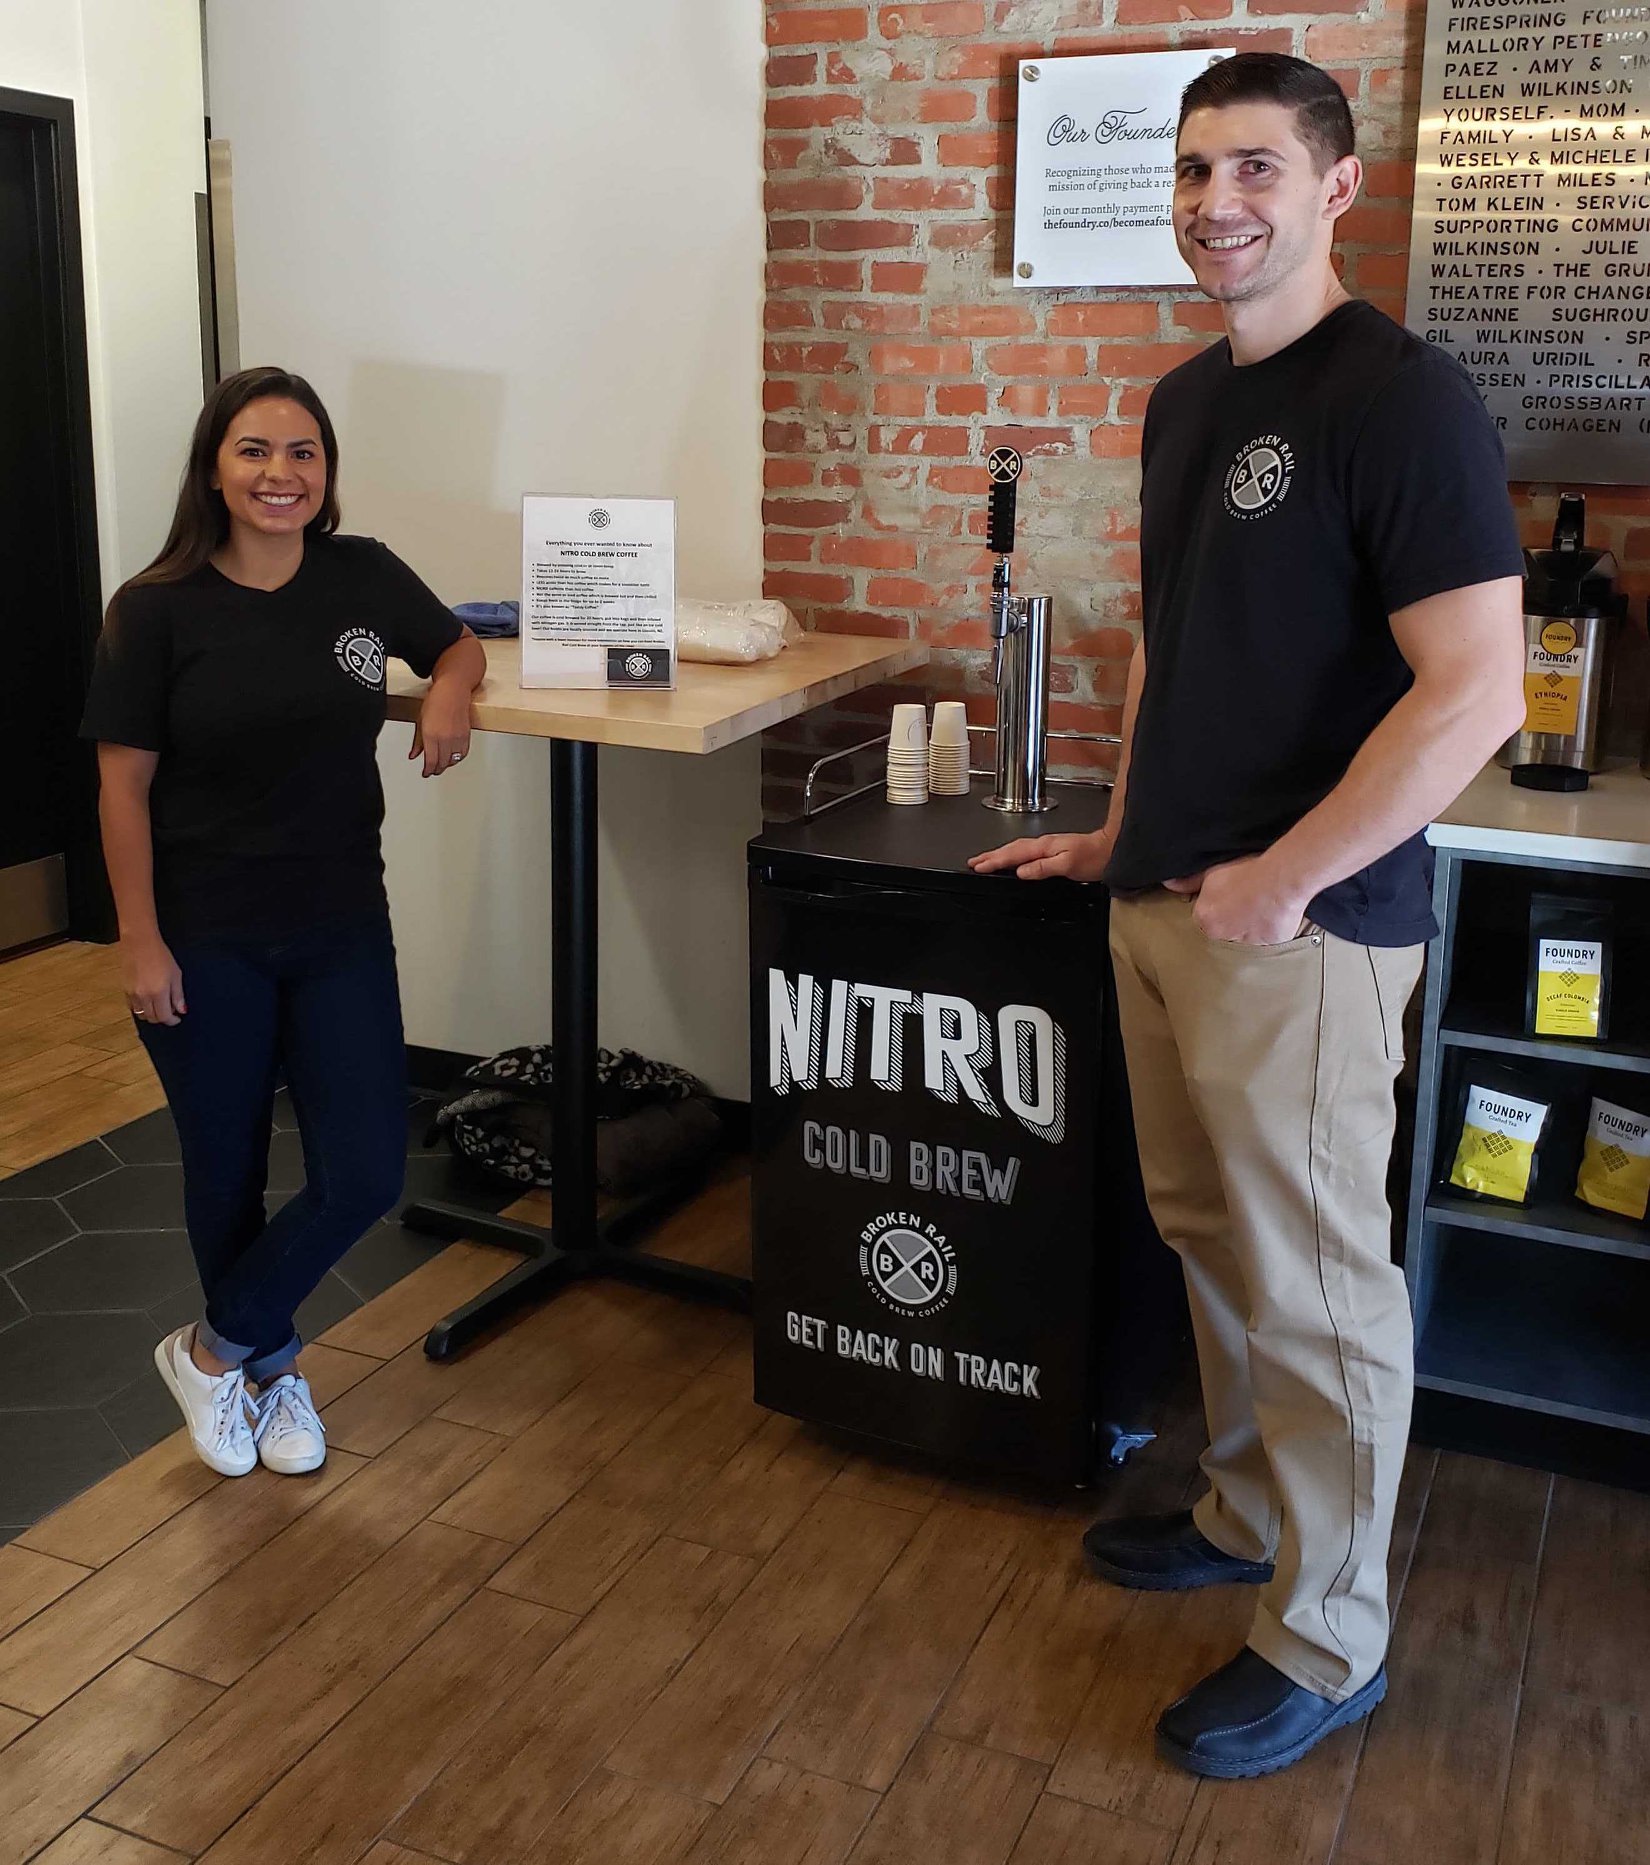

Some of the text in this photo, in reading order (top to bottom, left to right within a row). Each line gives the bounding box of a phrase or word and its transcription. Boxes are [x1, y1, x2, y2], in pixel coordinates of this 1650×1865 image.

[1451, 0, 1565, 9] WAGGO
[1448, 12, 1566, 32] FIRESPRING
[1447, 36, 1545, 55] MALLORY
[1445, 61, 1498, 77] PAEZ
[1528, 58, 1574, 74] AMY
[1589, 56, 1602, 71] &
[1443, 79, 1633, 100] ELLEN WILKINSON
[1443, 102, 1626, 122] YOURSELF. MOM
[1047, 114, 1090, 146] Our
[1440, 129, 1515, 145] FAMILY
[1551, 127, 1597, 142] LISA
[1612, 125, 1625, 140] &
[1439, 152, 1519, 167] WESELY
[1528, 151, 1541, 166] &
[1550, 149, 1637, 165] MICHELE
[1045, 165, 1102, 179] Recognizing
[1104, 163, 1130, 176] those
[1132, 163, 1152, 174] who
[1048, 179, 1085, 192] mission
[1086, 179, 1098, 191] of
[1098, 179, 1128, 193] giving
[1130, 178, 1153, 189] back
[1451, 172, 1616, 189] GARRETT MILES
[1043, 204, 1061, 217] Join
[1063, 207, 1079, 216] our
[1081, 203, 1121, 217] monthly
[1122, 204, 1164, 216] payment
[1436, 197, 1476, 212] TOM
[1487, 196, 1544, 211] KLEIN
[1434, 218, 1559, 234] SUPPORTING
[1432, 240, 1639, 256] WILKINSON JULIE
[1431, 263, 1525, 278] WALTERS
[1552, 262, 1591, 278] THE
[1429, 285, 1519, 300] THEATRE
[1526, 285, 1566, 300] FOR
[1427, 307, 1519, 322] SUZANNE
[1425, 329, 1455, 344] GIL
[1476, 330, 1584, 345] WILKINSON
[1532, 351, 1595, 367] URIDIL
[1471, 372, 1525, 388] SSEN
[1521, 395, 1645, 411] GROSSBART
[1525, 417, 1621, 433] COHAGEN
[1235, 435, 1295, 474] BROKEN RAIL
[989, 460, 1017, 471] B R
[1236, 469, 1275, 490] B R
[334, 627, 366, 654] BROKEN
[1545, 633, 1572, 642] FOUNDRY
[351, 654, 381, 667] B R
[1533, 651, 1579, 664] FOUNDRY
[1534, 691, 1568, 702] ETHIOPIA
[1545, 947, 1596, 960] FOUNDRY
[768, 967, 1066, 1144] NITRO
[1478, 1099, 1532, 1123] FOUNDRY
[1597, 1111, 1649, 1138] FOUNDRY
[803, 1119, 1022, 1206] COLD BREW
[860, 1211, 956, 1262] BROKEN RAIL
[880, 1253, 936, 1281] B R
[867, 1281, 949, 1318] COLD BREW COFFEE
[786, 1310, 1042, 1400] GET BACK ON TRACK
